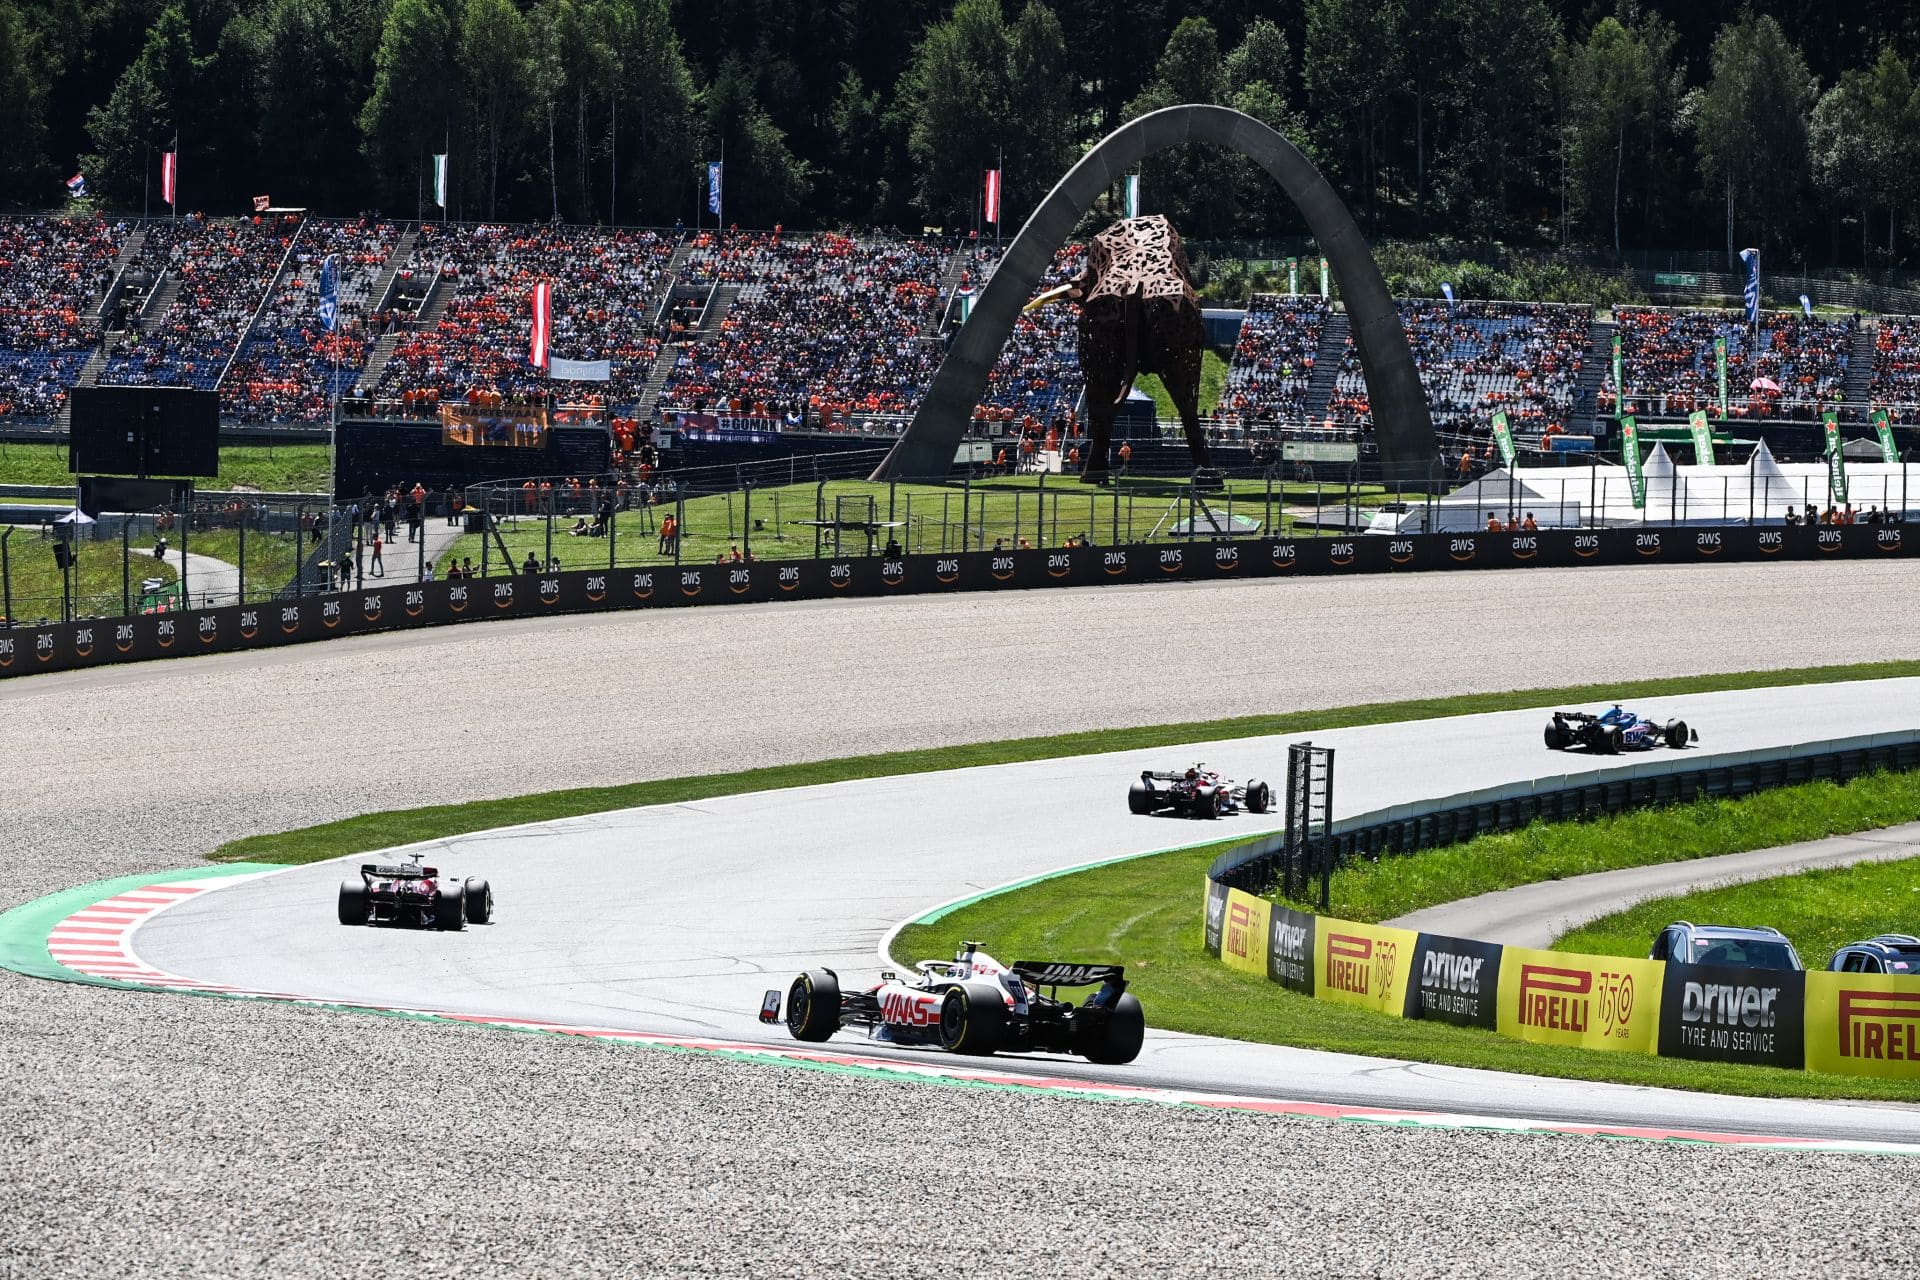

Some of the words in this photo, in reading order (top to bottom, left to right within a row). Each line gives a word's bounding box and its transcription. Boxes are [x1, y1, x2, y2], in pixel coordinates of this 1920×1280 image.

[516, 423, 543, 433] MAX
[720, 418, 777, 431] #GOMAX
[1575, 535, 1598, 547] aws
[1636, 534, 1659, 545] aws
[1698, 533, 1720, 544] aws
[1759, 532, 1781, 543] aws
[1819, 531, 1841, 542] aws
[1878, 530, 1900, 541] aws
[1331, 543, 1353, 555] aws
[1390, 541, 1412, 553] aws
[1451, 539, 1474, 551] aws
[1513, 537, 1536, 549] aws
[1160, 550, 1181, 562] aws
[1216, 547, 1237, 559] aws
[1273, 545, 1294, 557] aws
[993, 557, 1013, 569] aws
[1049, 555, 1069, 567] aws
[1105, 552, 1126, 564] aws
[831, 564, 850, 577] aws
[883, 562, 903, 575] aws
[937, 560, 958, 572] aws
[682, 572, 700, 584] aws
[730, 570, 749, 583] aws
[780, 567, 799, 580] aws
[541, 580, 558, 593] aws
[587, 576, 605, 590] aws
[634, 574, 652, 587] aws
[450, 586, 467, 600] aws
[495, 583, 512, 597] aws
[365, 595, 381, 610] aws
[407, 590, 423, 605] aws
[282, 607, 298, 621] aws
[324, 601, 339, 616] aws
[200, 616, 216, 631] aws
[241, 611, 257, 626] aws
[117, 624, 133, 640] aws
[158, 620, 174, 635] aws
[37, 634, 53, 650] aws
[77, 629, 92, 645] aws
[1327, 933, 1372, 995] PIRELLI
[1041, 964, 1111, 984] HAAS
[1421, 991, 1436, 1008] TYRE
[1439, 994, 1450, 1011] AND
[1452, 996, 1478, 1016] SERVICE
[1518, 964, 1592, 1033] PIRELLI
[881, 993, 937, 1026] HAAS
[1682, 1026, 1705, 1046] TYRE
[1710, 1030, 1728, 1049] AND
[1733, 1031, 1775, 1053] SERVICE
